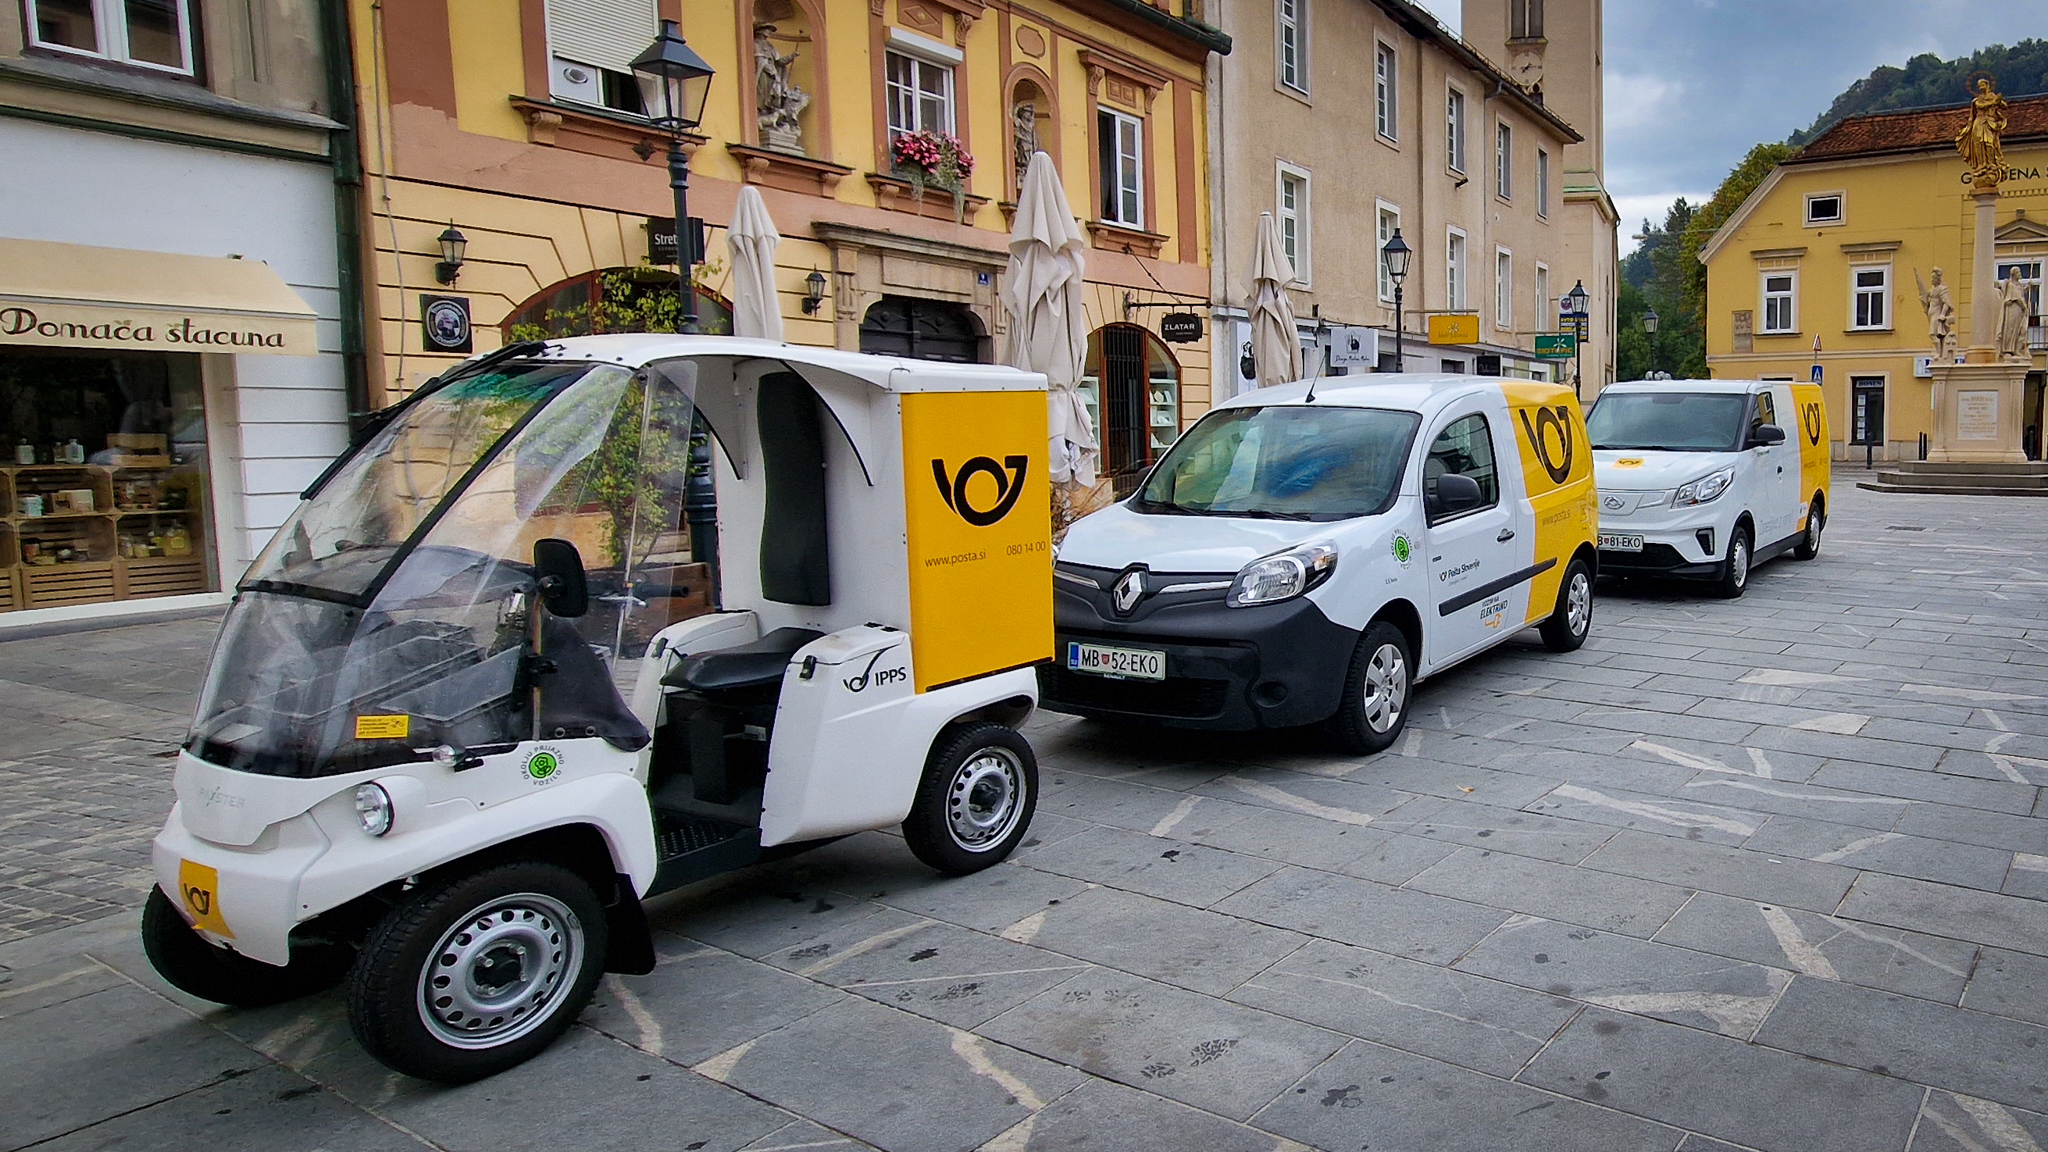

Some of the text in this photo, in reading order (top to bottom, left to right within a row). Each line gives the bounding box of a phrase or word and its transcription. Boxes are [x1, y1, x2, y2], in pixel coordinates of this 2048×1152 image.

[1960, 167, 2041, 184] GBENA
[654, 233, 678, 245] Stret
[0, 307, 286, 348] Domača štacuna
[1164, 323, 1195, 331] ZLATAR
[1610, 536, 1640, 548] 81-EKO
[925, 540, 1046, 567] www.posta.si 080 14 00
[1081, 649, 1158, 674] MB 52-EKO
[875, 666, 907, 686] IPPS
[534, 745, 565, 765] PRIJAZNO
[520, 751, 533, 780] OKOLJU
[533, 770, 562, 786] VOZILO
